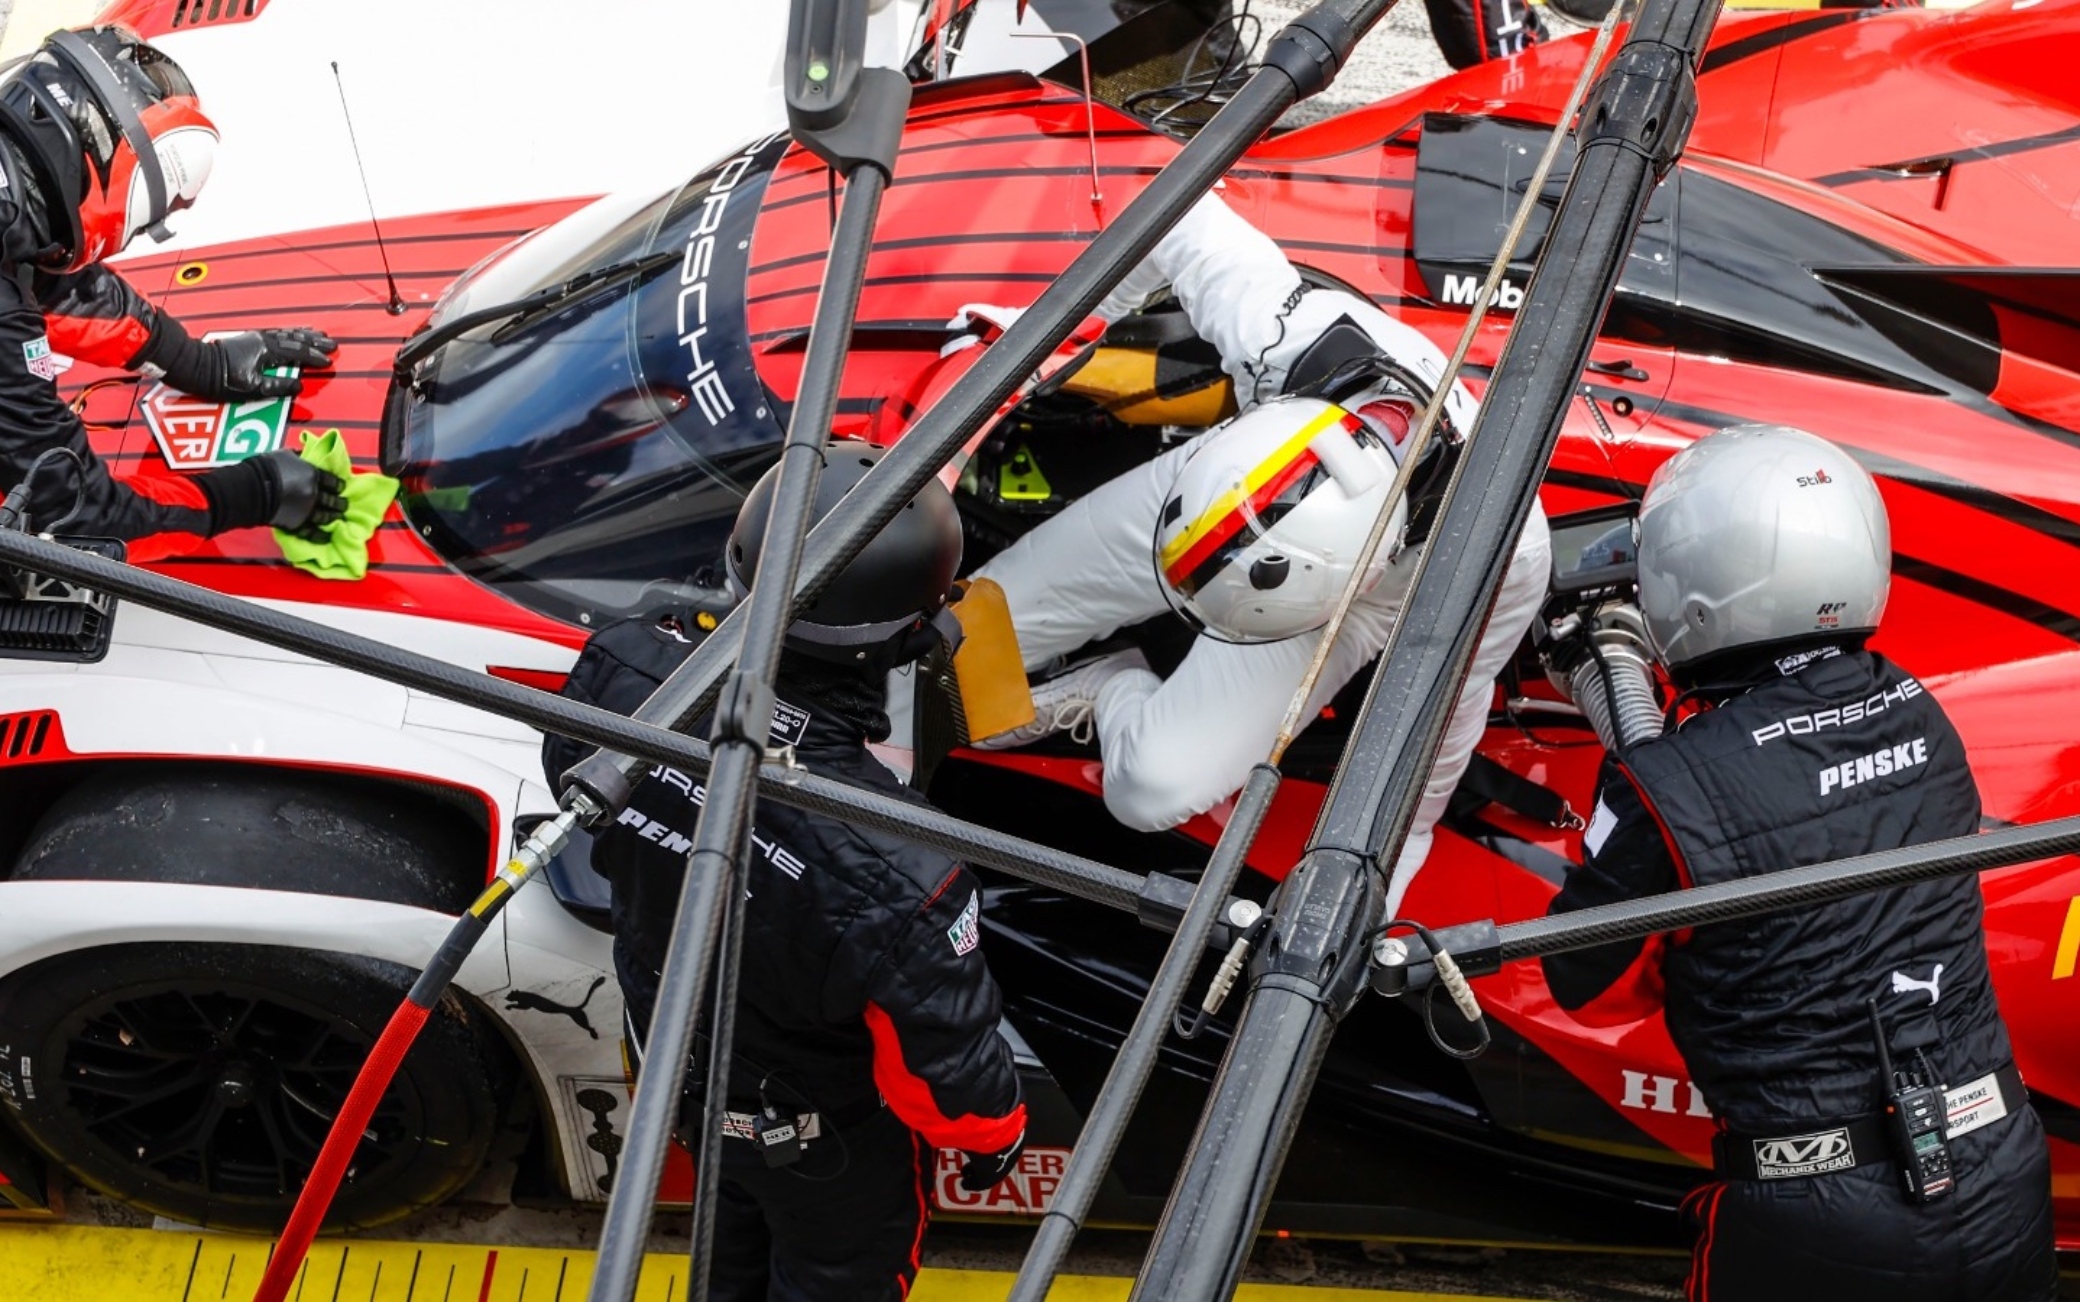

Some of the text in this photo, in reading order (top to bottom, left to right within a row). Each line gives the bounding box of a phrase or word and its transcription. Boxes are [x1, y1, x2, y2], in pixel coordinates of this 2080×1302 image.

[1441, 273, 1525, 309] Mob
[154, 389, 219, 459] UER
[1752, 677, 1922, 746] PORSCHE
[1820, 737, 1928, 796] PENSKE
[617, 806, 693, 858] PEN
[1959, 1087, 1988, 1108] PENSKE
[940, 1151, 1064, 1175] HER
[1761, 1155, 1850, 1177] MECHANIX WEAR
